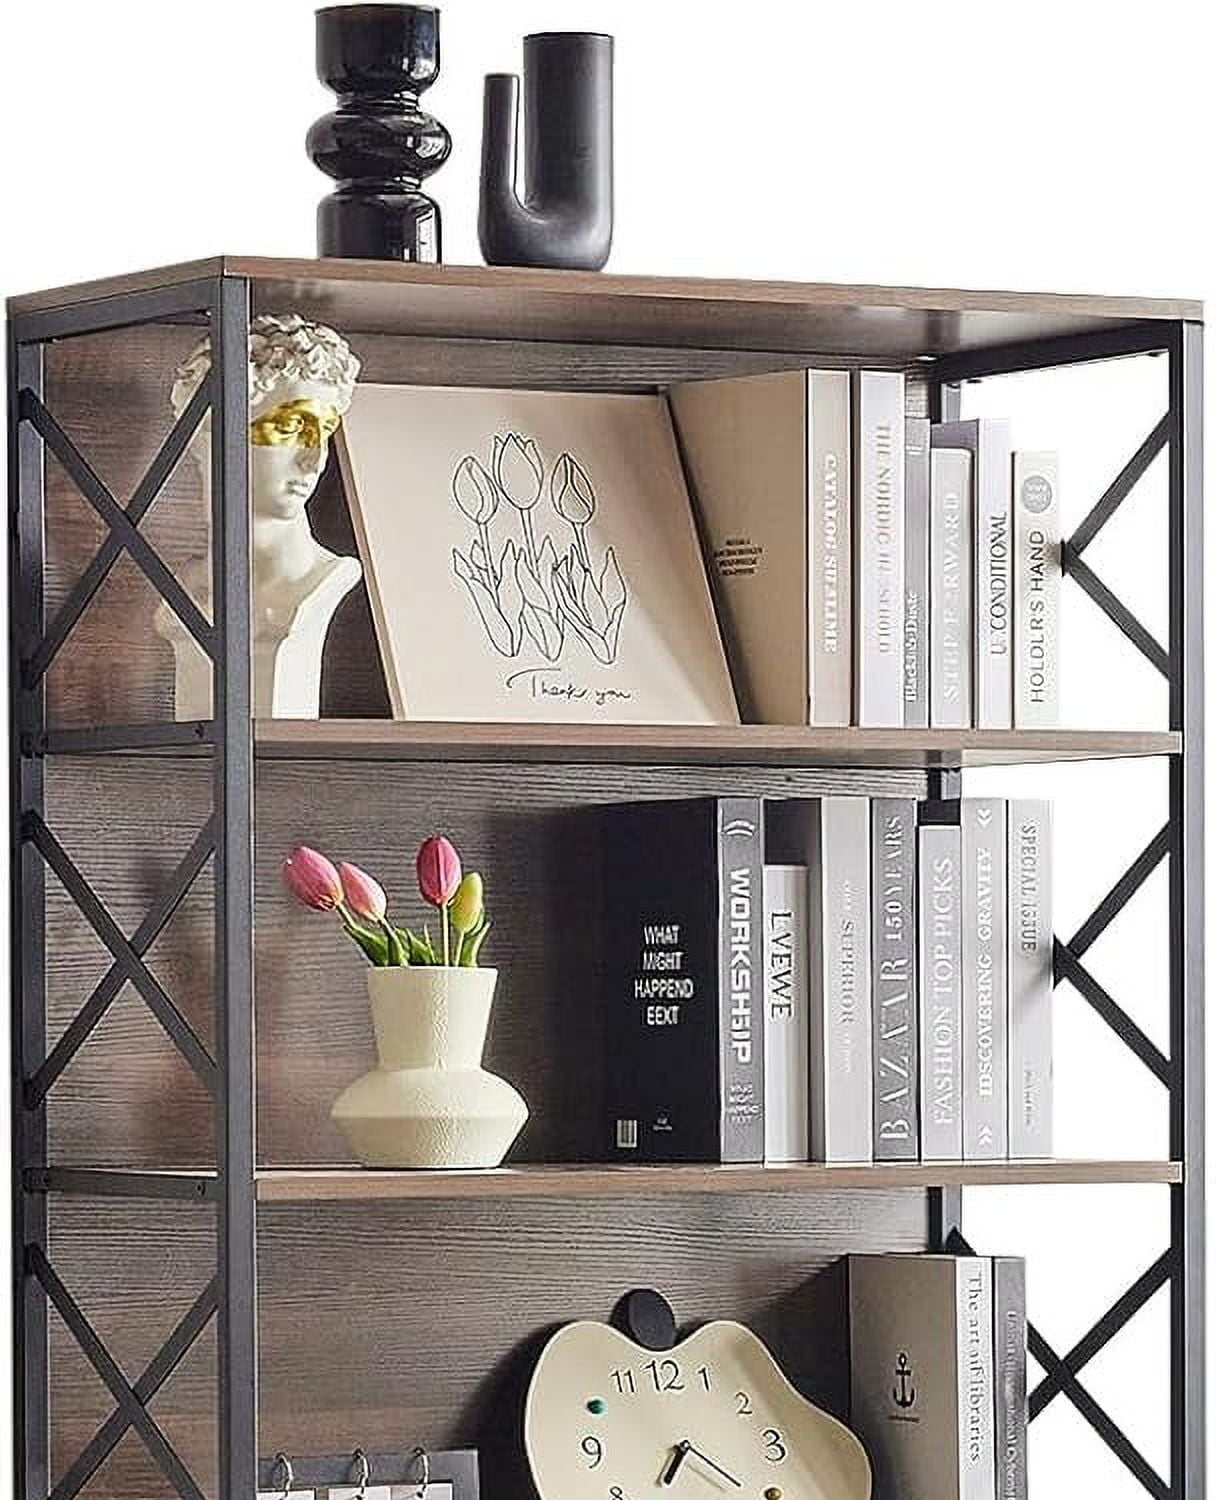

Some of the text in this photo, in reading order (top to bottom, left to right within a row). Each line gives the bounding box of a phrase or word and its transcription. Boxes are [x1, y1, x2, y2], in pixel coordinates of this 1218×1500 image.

[824, 454, 838, 549] CATALOG
[876, 467, 892, 546] NORDIC
[990, 511, 1007, 655] UCONDITIONAL
[1029, 530, 1045, 592] HAND
[506, 668, 631, 706] Thank you
[1020, 824, 1037, 895] SPECIAL
[977, 847, 994, 942] GRAVITY
[643, 951, 684, 970] MIGHT
[644, 925, 680, 945] WHAT
[634, 978, 694, 999] HAPPEND
[932, 857, 954, 1125] FASHION TOP PICKS
[879, 957, 910, 1140] BAZAAR
[968, 1273, 982, 1311] The
[968, 1318, 980, 1344] art
[610, 1360, 710, 1393] 11 12 1
[735, 1391, 753, 1415] 2
[969, 1380, 985, 1462] libraries
[582, 1429, 786, 1469] 9 3
